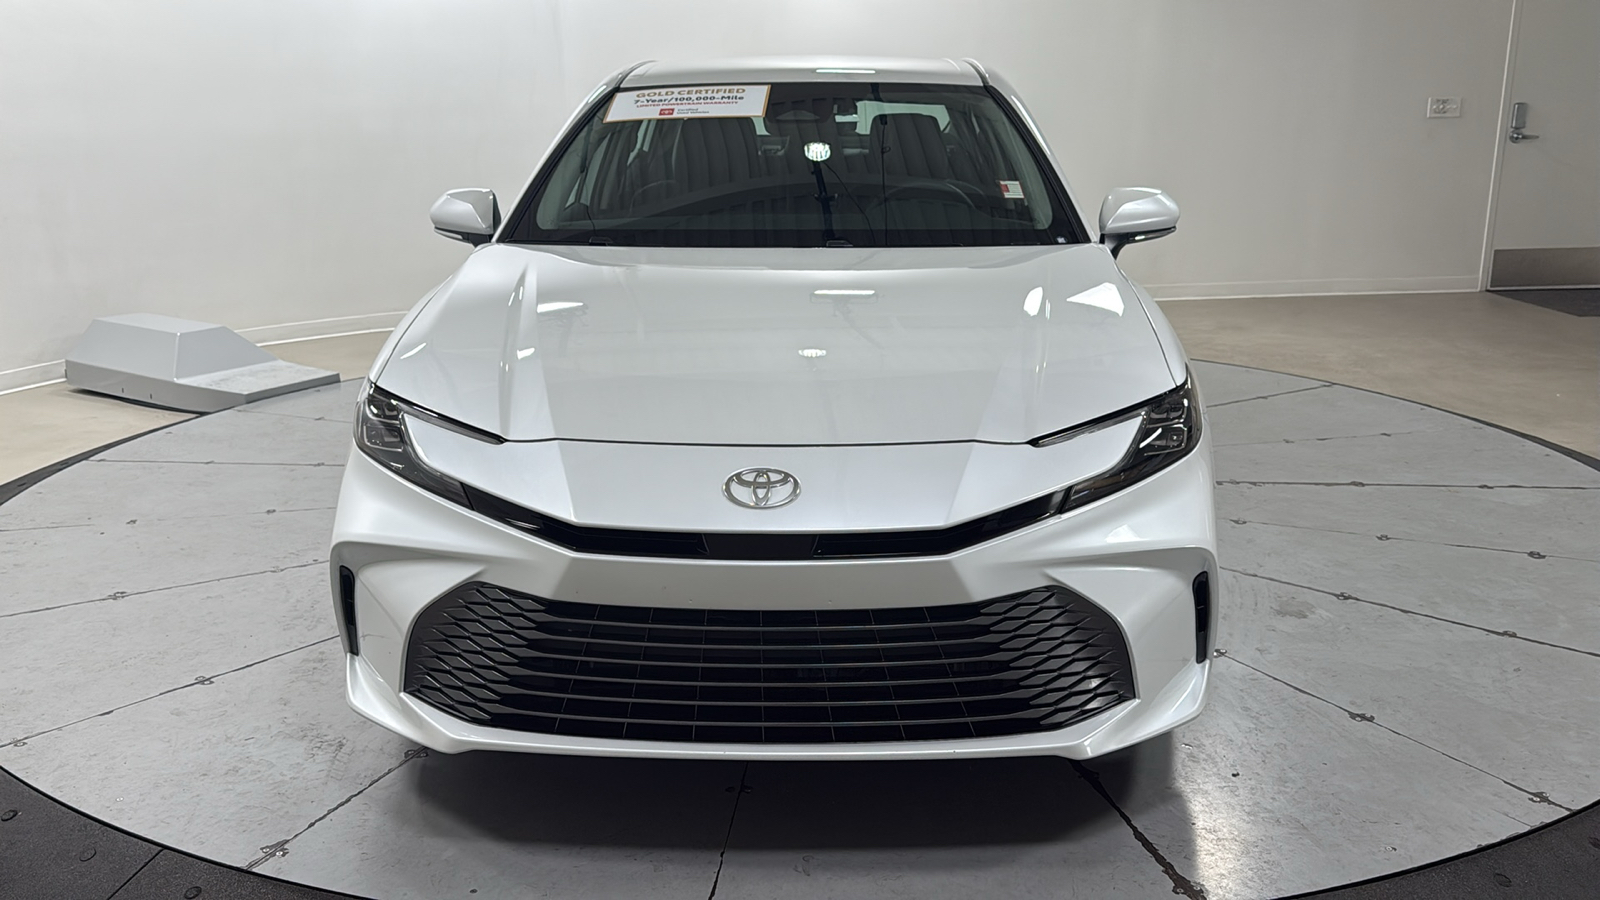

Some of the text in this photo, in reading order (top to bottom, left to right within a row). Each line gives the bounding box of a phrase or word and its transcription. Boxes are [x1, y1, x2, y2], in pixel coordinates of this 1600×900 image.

[636, 88, 746, 98] GOLD CERTIFIED
[634, 95, 745, 104] 7-Year/100,000-Mile
